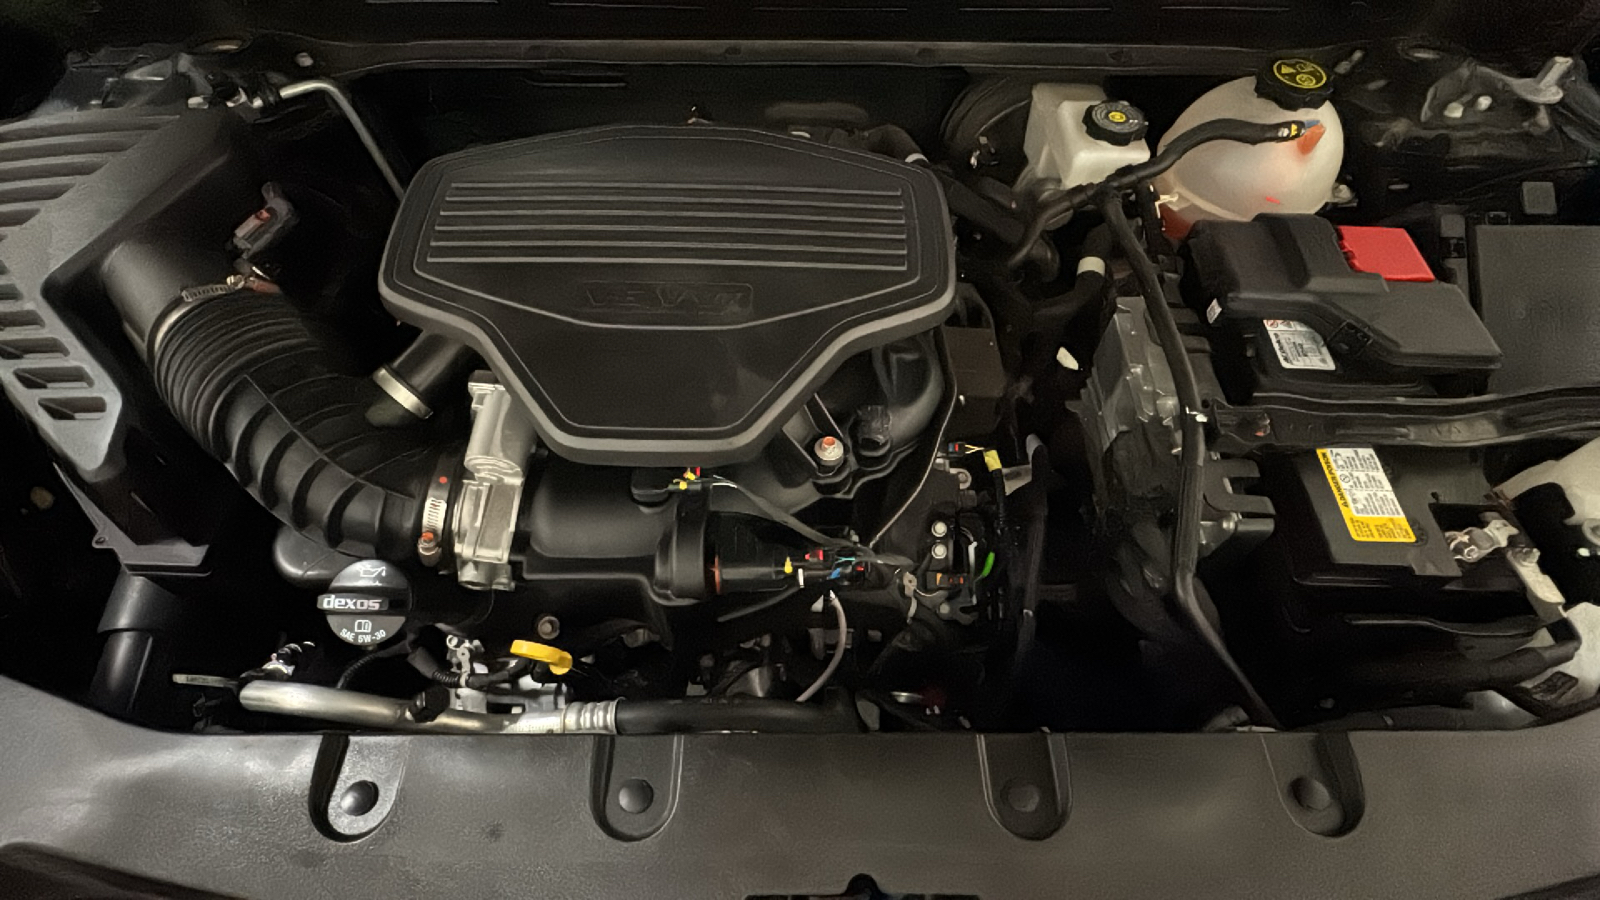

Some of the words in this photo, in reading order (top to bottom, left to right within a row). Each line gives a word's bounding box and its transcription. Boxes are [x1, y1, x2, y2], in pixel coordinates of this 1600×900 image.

[322, 594, 382, 610] dexos
[340, 628, 356, 642] SAE
[357, 629, 386, 643] 5W-30
